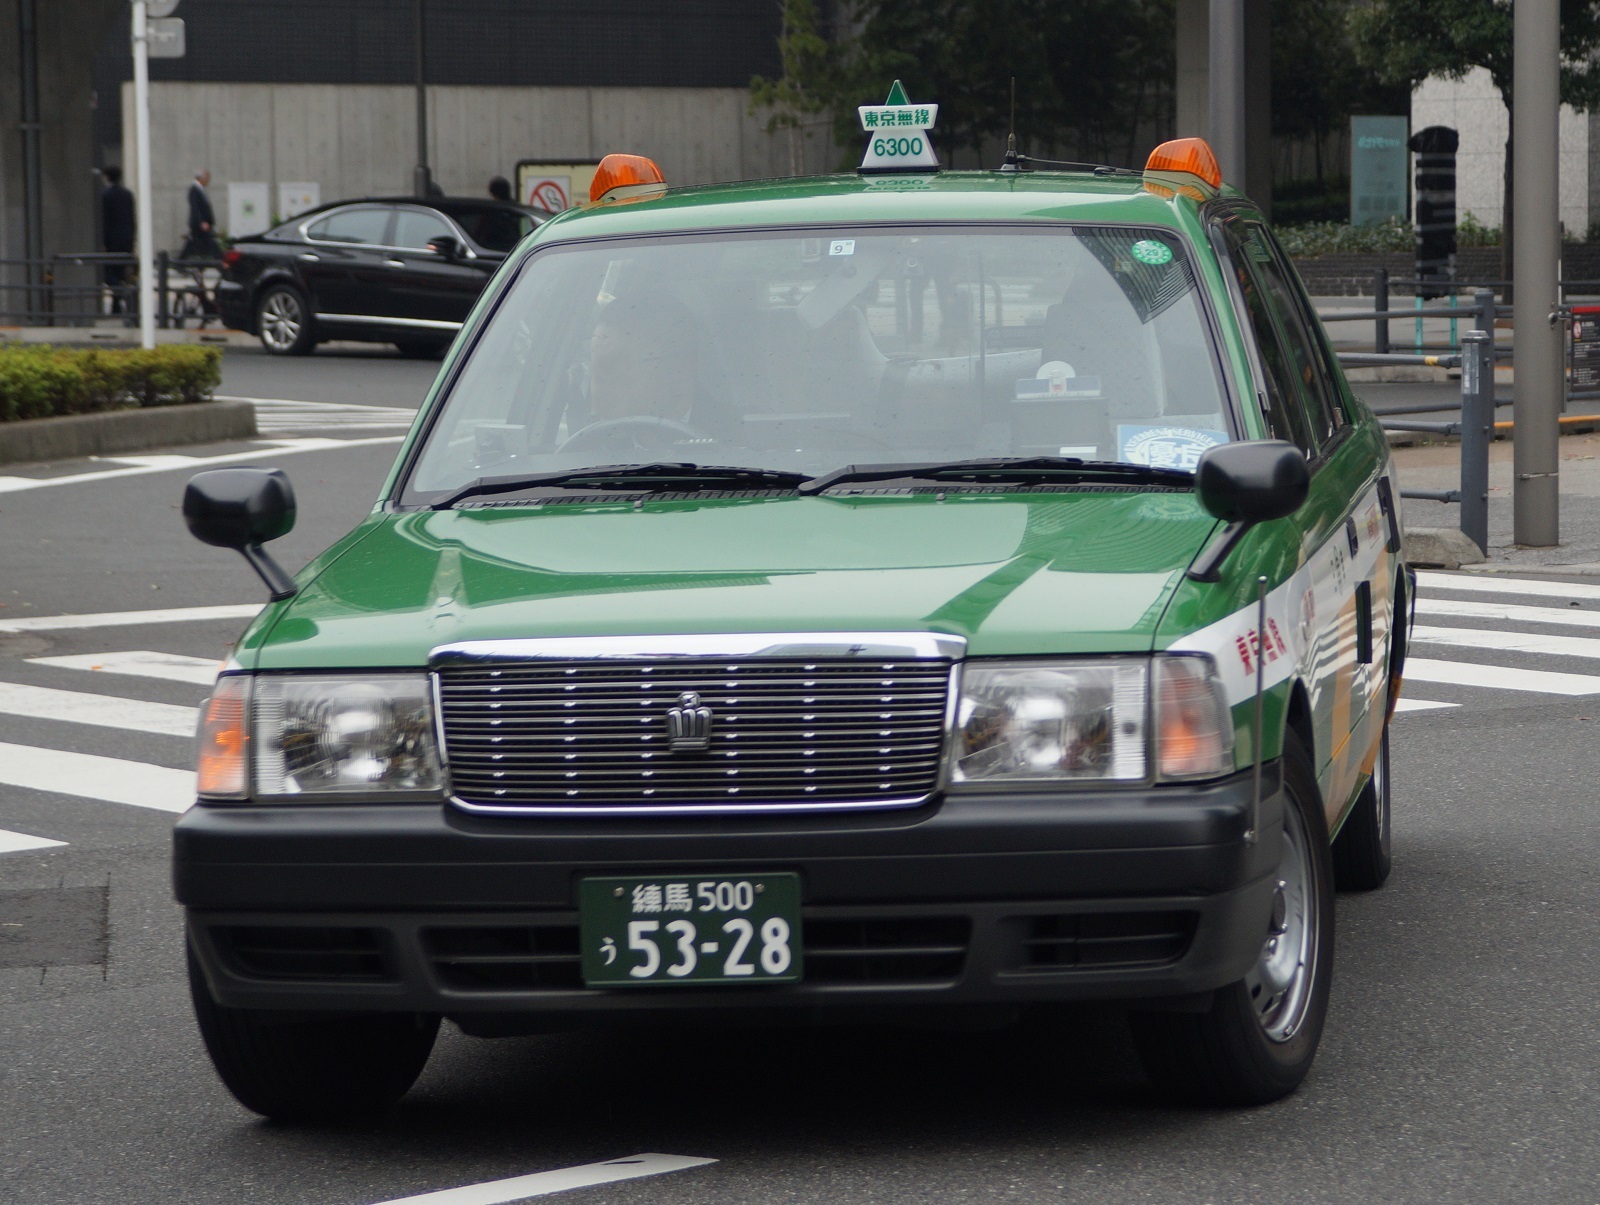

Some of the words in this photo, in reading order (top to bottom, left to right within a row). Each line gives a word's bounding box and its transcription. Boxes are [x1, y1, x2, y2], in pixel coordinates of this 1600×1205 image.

[864, 109, 930, 127] 東京無線
[874, 137, 923, 157] 6300
[631, 883, 693, 913] 練馬
[697, 880, 754, 912] 500
[598, 936, 617, 966] う
[628, 916, 791, 978] 53-28
